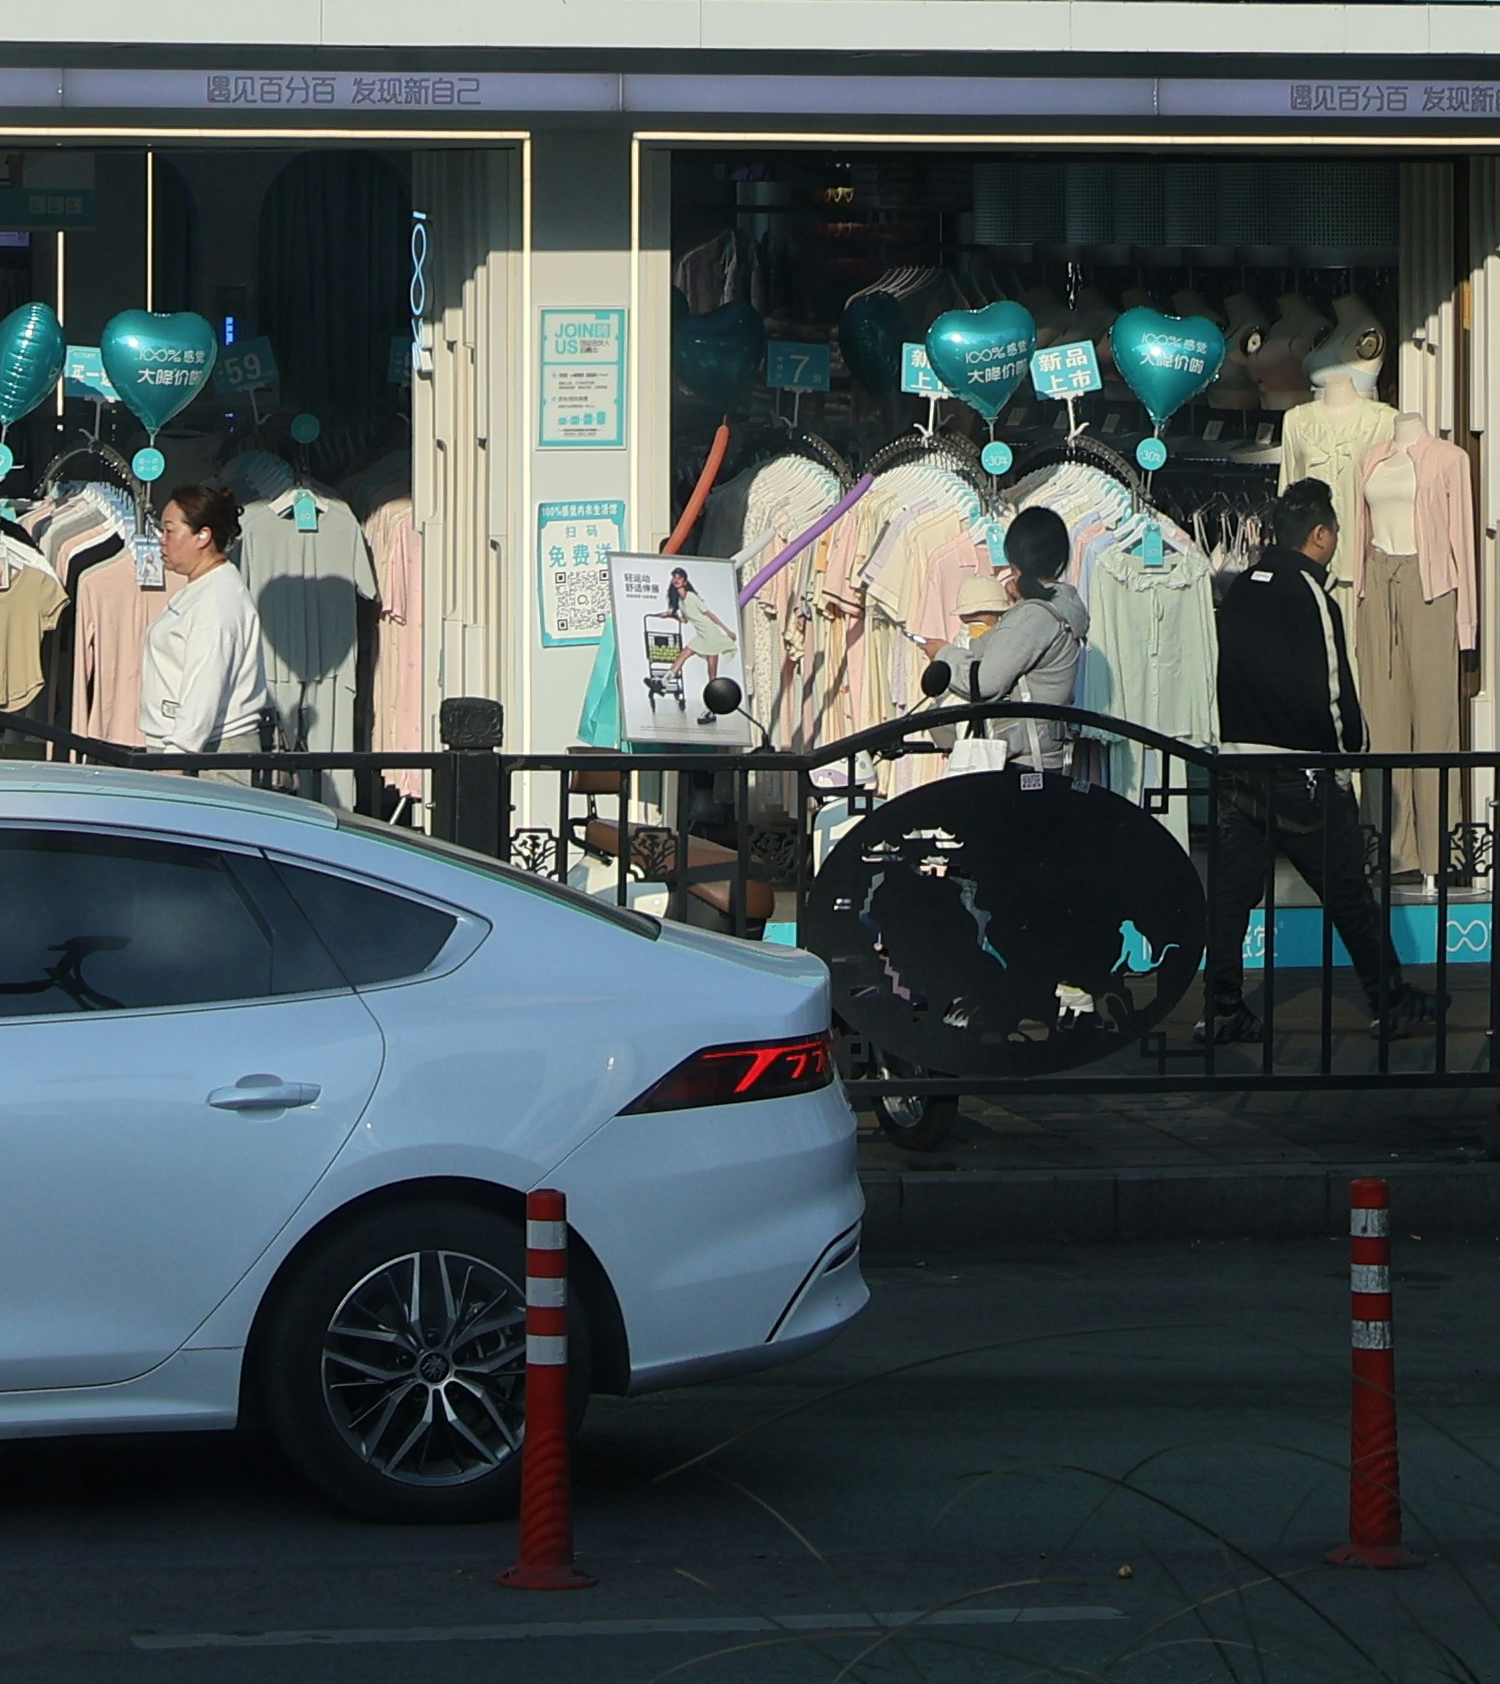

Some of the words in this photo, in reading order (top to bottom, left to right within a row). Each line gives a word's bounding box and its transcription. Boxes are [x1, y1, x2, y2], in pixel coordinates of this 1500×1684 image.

[206, 75, 337, 104] 遇见百分百
[351, 77, 482, 105] 发现新自己
[1289, 84, 1409, 112] 遇见百分百
[555, 339, 578, 355] US
[1037, 350, 1090, 373] 新品
[1049, 369, 1092, 395] 上市
[565, 524, 598, 539] 扫码
[624, 572, 650, 583] 轻运动
